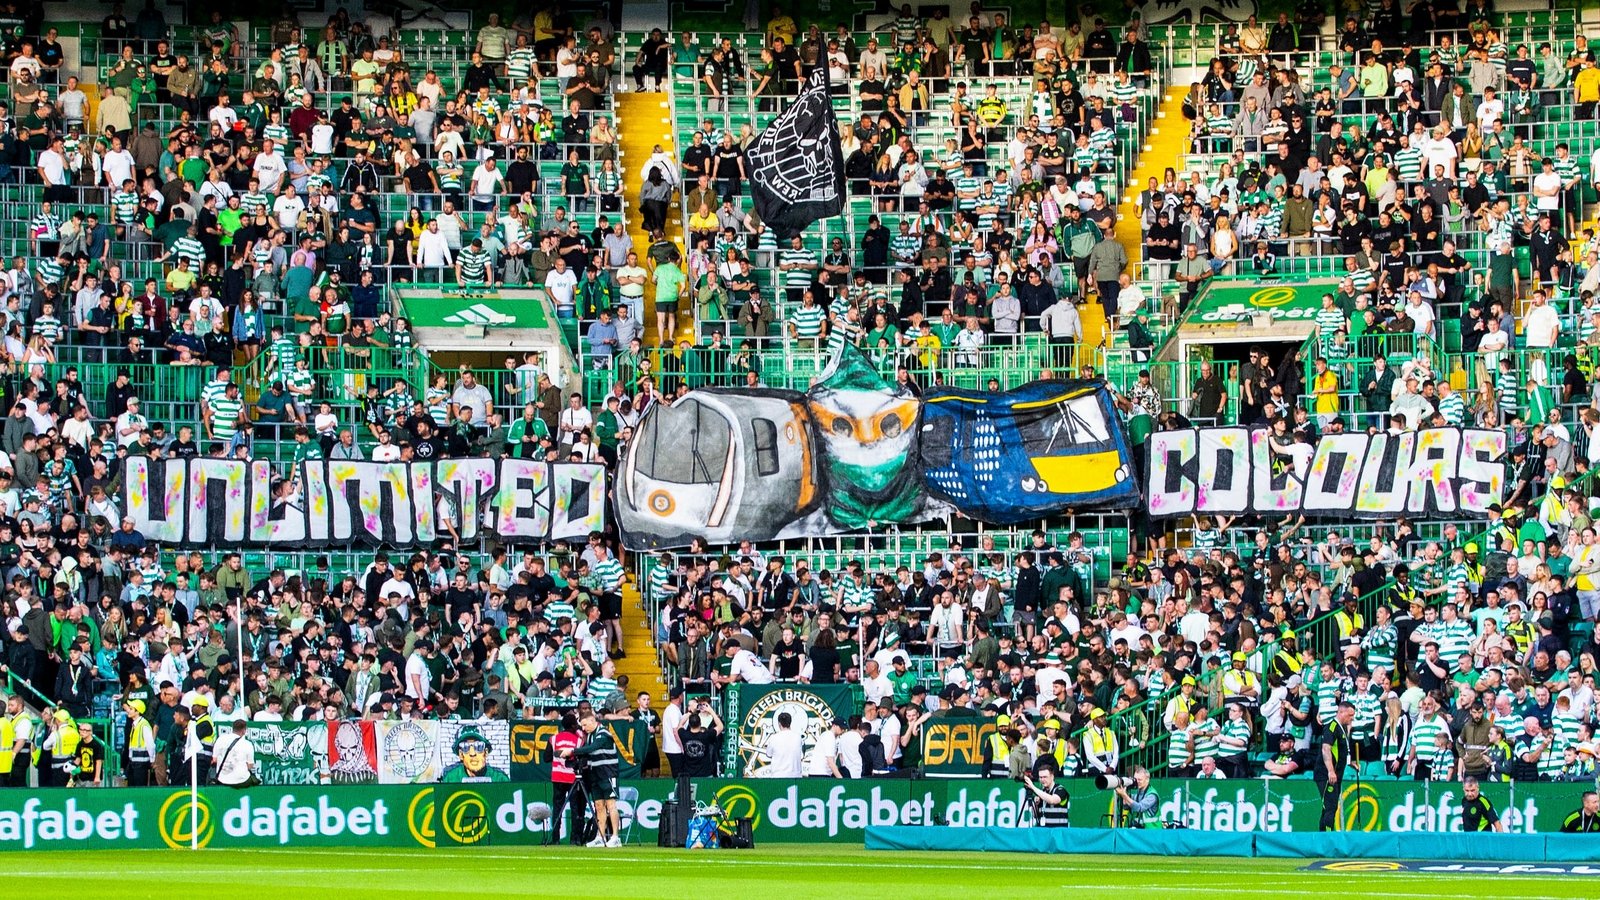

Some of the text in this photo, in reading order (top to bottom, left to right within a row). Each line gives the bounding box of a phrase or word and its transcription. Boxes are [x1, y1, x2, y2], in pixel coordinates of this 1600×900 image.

[1201, 306, 1318, 322] dafbet
[1149, 426, 1507, 514] COLOURS
[125, 456, 605, 543] UNLIMITED
[727, 690, 738, 769] GREEN BRIGADE
[747, 690, 836, 728] GREEN BRIGADE
[222, 794, 389, 844] dafabet
[767, 785, 935, 837] dafabet
[946, 787, 1037, 828] dafab
[1160, 787, 1294, 832] dafabet
[1389, 791, 1539, 834] dafaet
